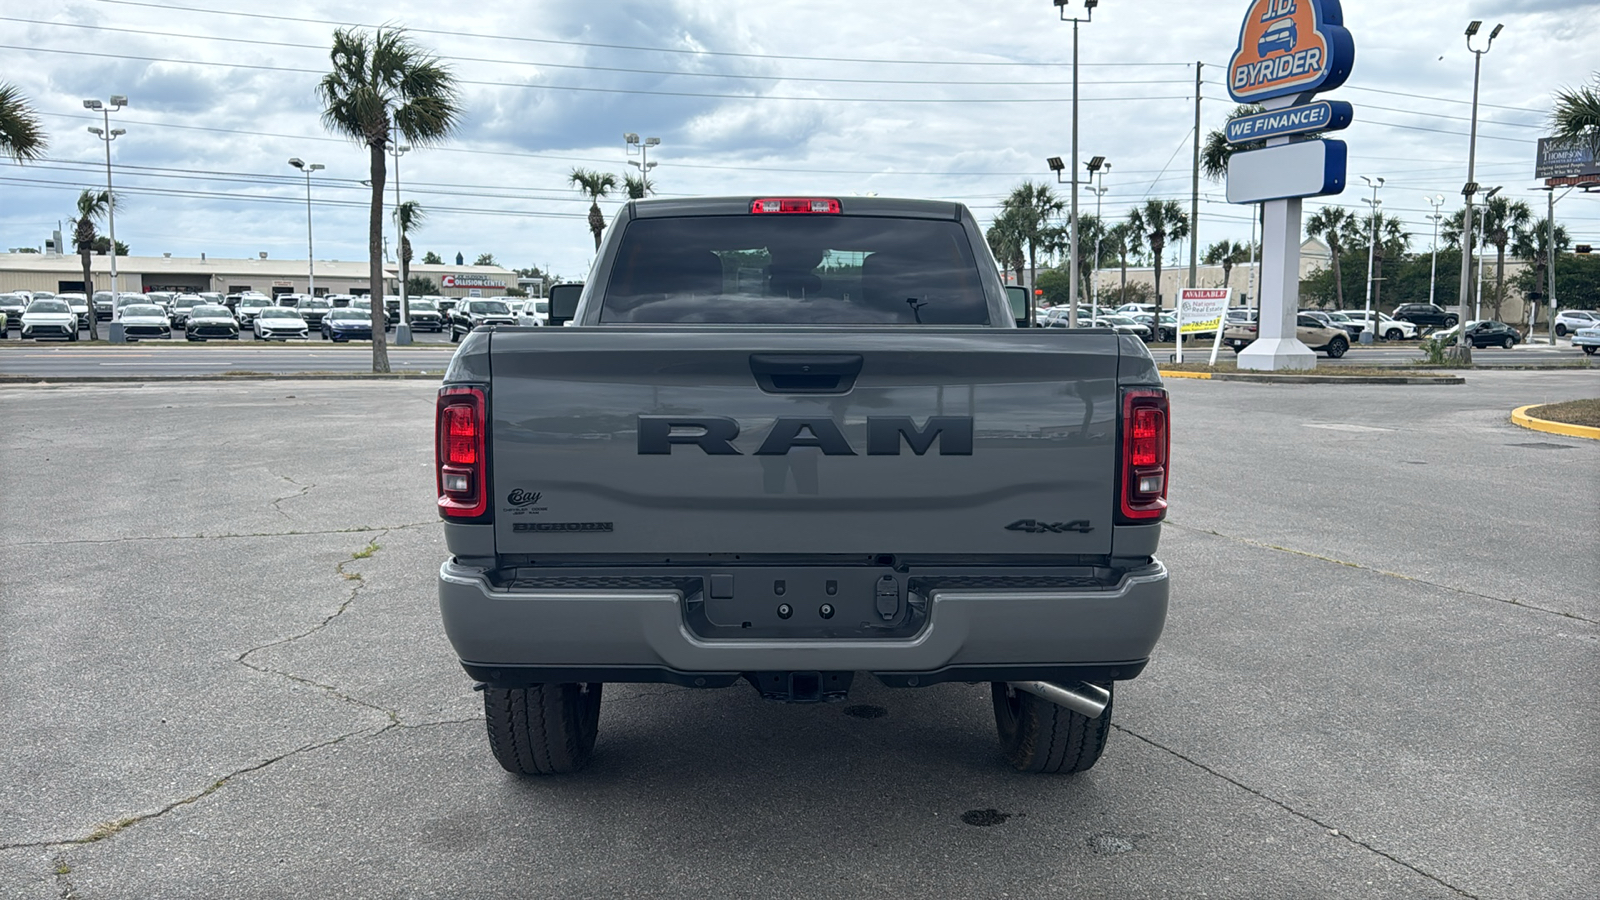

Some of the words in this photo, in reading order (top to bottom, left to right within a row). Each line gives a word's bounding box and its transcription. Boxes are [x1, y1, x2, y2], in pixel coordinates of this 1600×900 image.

[1261, 0, 1295, 20] J.D.
[1233, 48, 1321, 89] BYRIDER
[1230, 121, 1253, 137] WE
[1254, 107, 1326, 132] FINANCE!
[1184, 290, 1226, 298] AVAILABLE
[637, 415, 974, 456] RAM
[507, 488, 543, 507] Bay
[512, 522, 614, 533] BIGHORN
